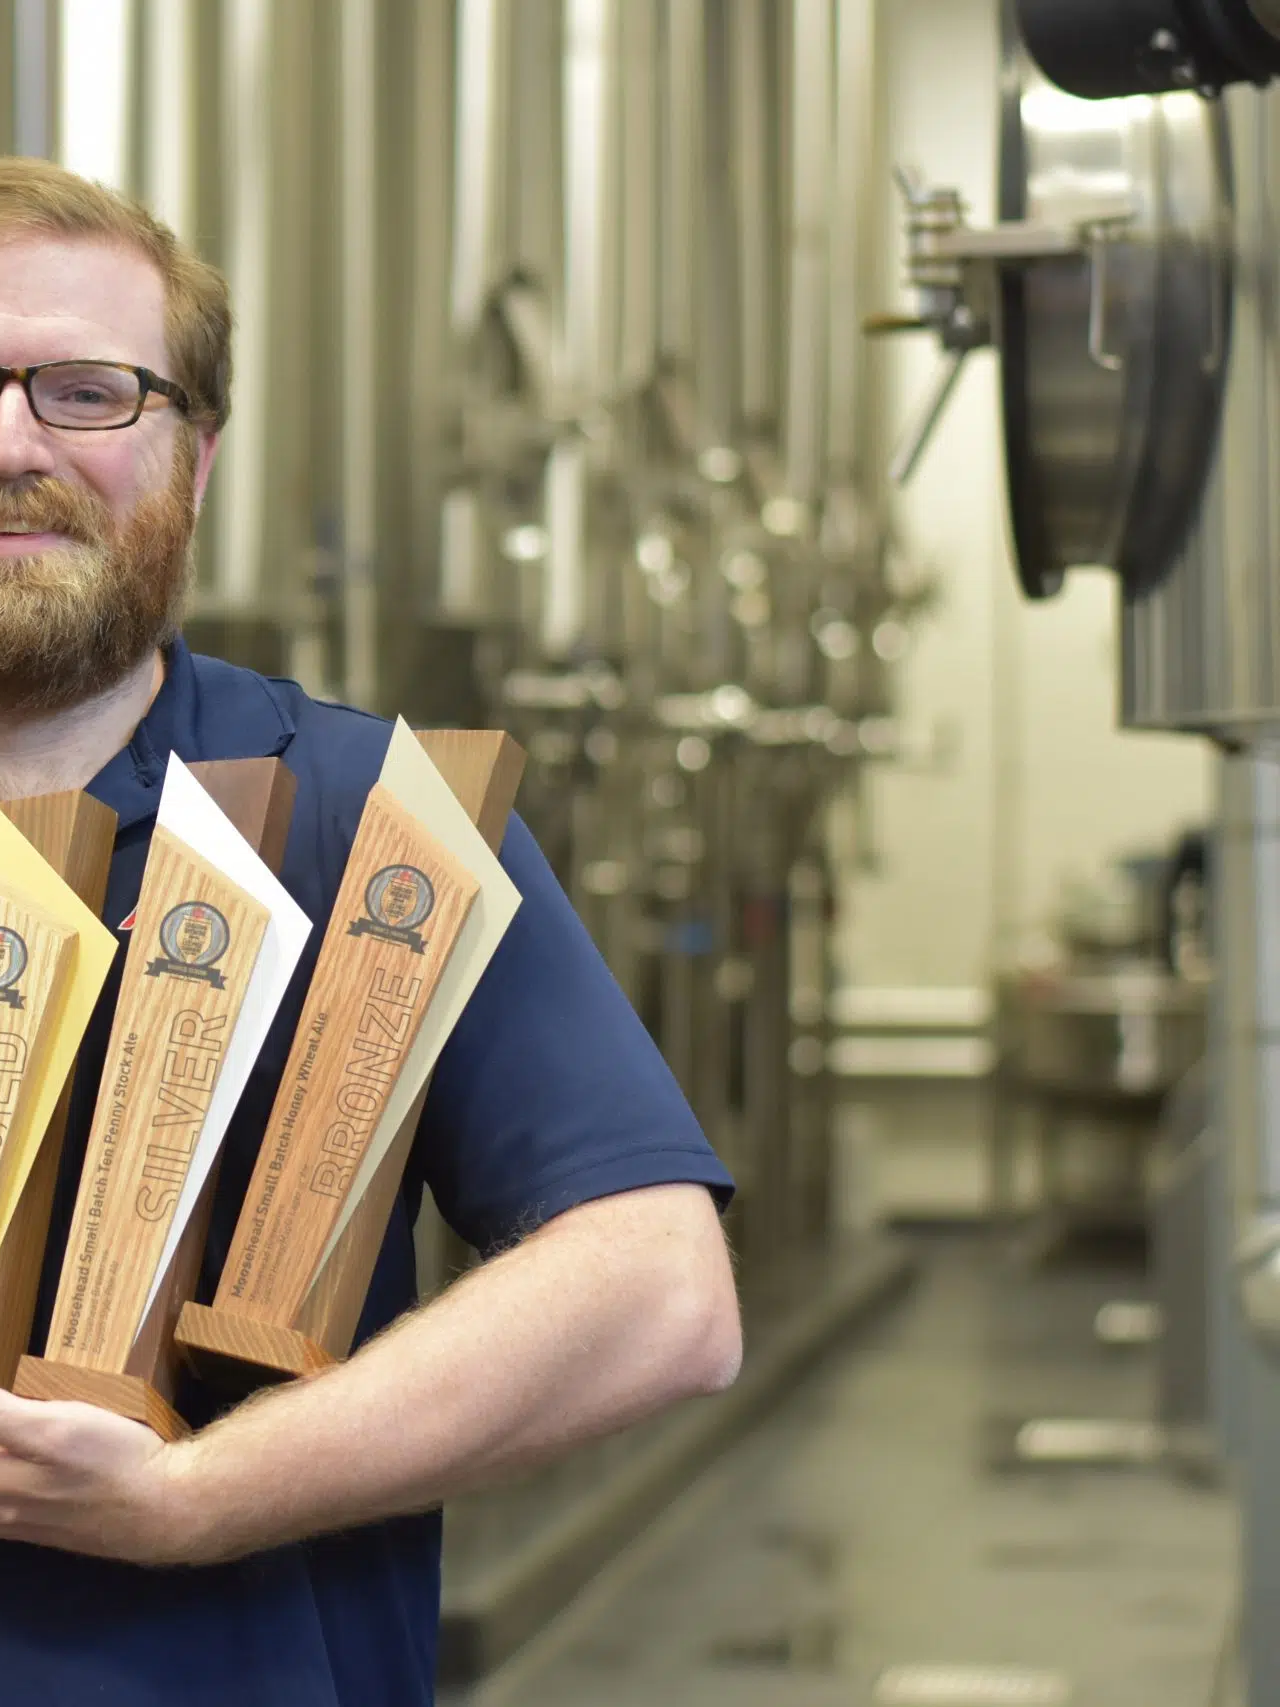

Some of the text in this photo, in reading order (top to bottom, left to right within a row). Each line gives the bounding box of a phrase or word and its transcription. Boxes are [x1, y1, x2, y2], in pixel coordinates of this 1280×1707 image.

[63, 1031, 136, 1348] Moosehead Small Batch Ten Penny Stock Ale
[136, 1009, 228, 1223] SILVER
[232, 1010, 326, 1298] Moosehead Small Batch Honey Wheat Ale
[309, 968, 422, 1199] BRONZE
